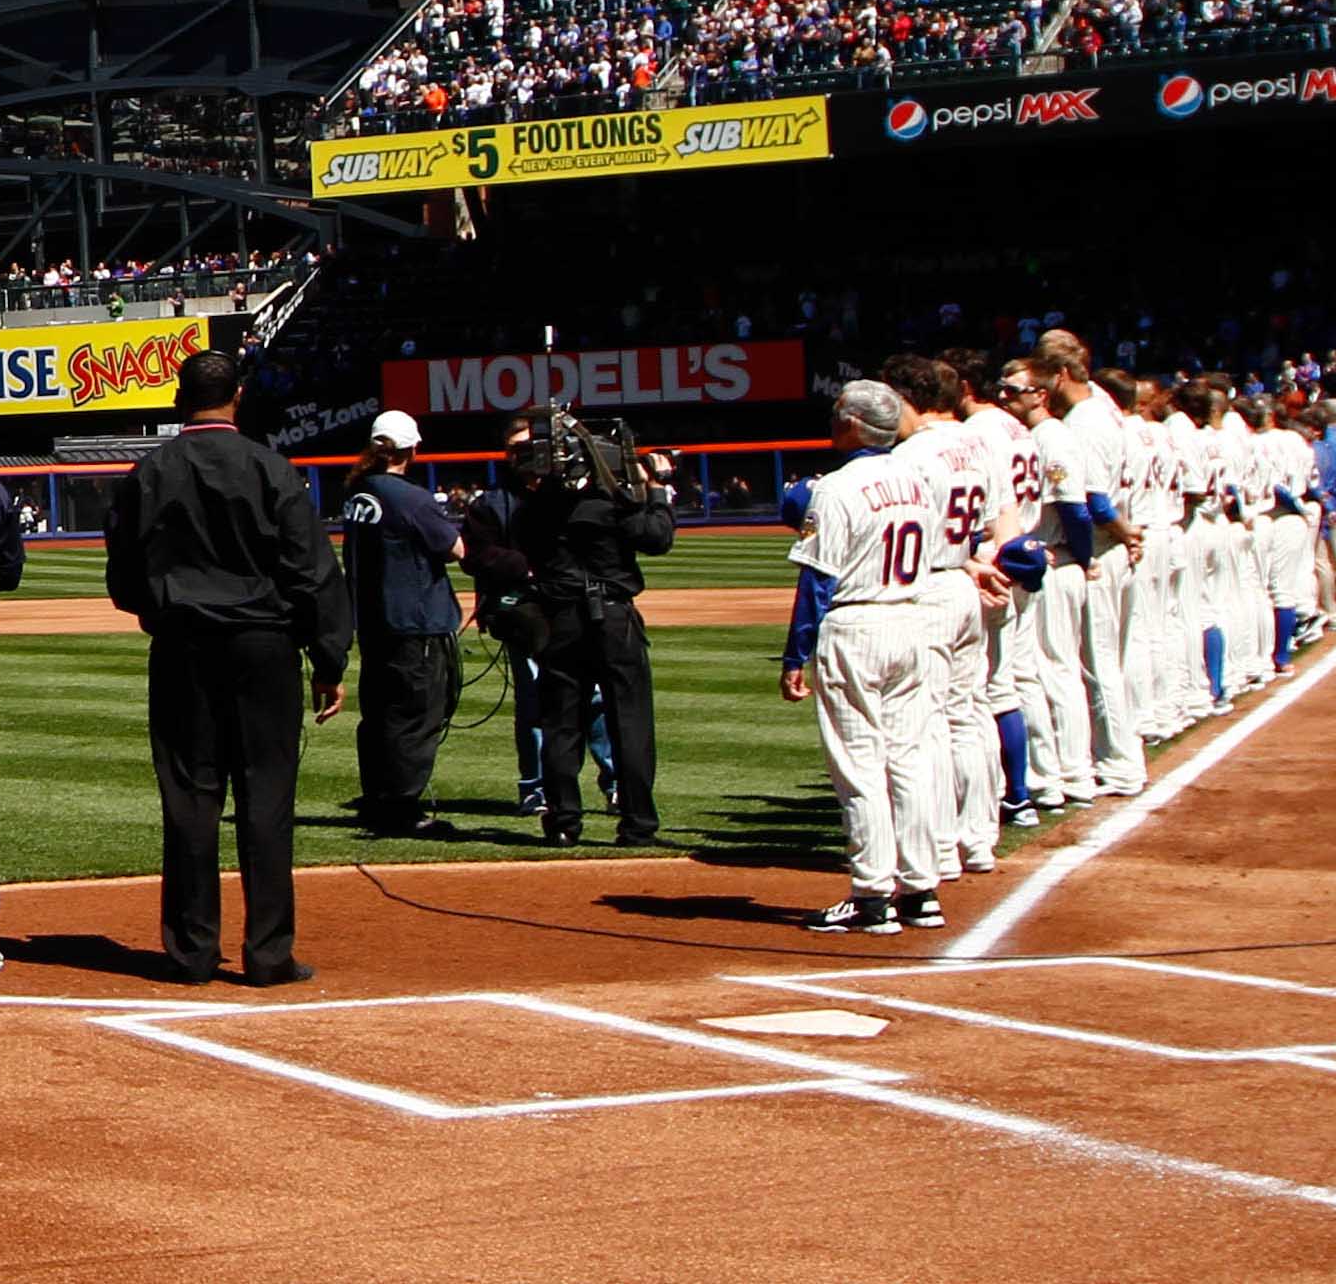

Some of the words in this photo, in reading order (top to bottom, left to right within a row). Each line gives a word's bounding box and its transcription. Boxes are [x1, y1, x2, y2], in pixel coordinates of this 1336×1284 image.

[933, 98, 1011, 131] pepsi
[1016, 88, 1101, 125] MAX
[1208, 73, 1295, 106] pepsi
[322, 144, 448, 188] SUBWAY
[453, 129, 499, 178] $5
[513, 114, 662, 155] FOOTLONGS
[675, 107, 820, 158] SUBWAY
[577, 154, 611, 168] EVERY
[68, 323, 201, 407] SNACKS
[428, 343, 751, 413] MODELL'S
[286, 402, 318, 419] The
[318, 397, 378, 430] Zone
[945, 485, 986, 545] 56
[882, 520, 924, 588] 10
